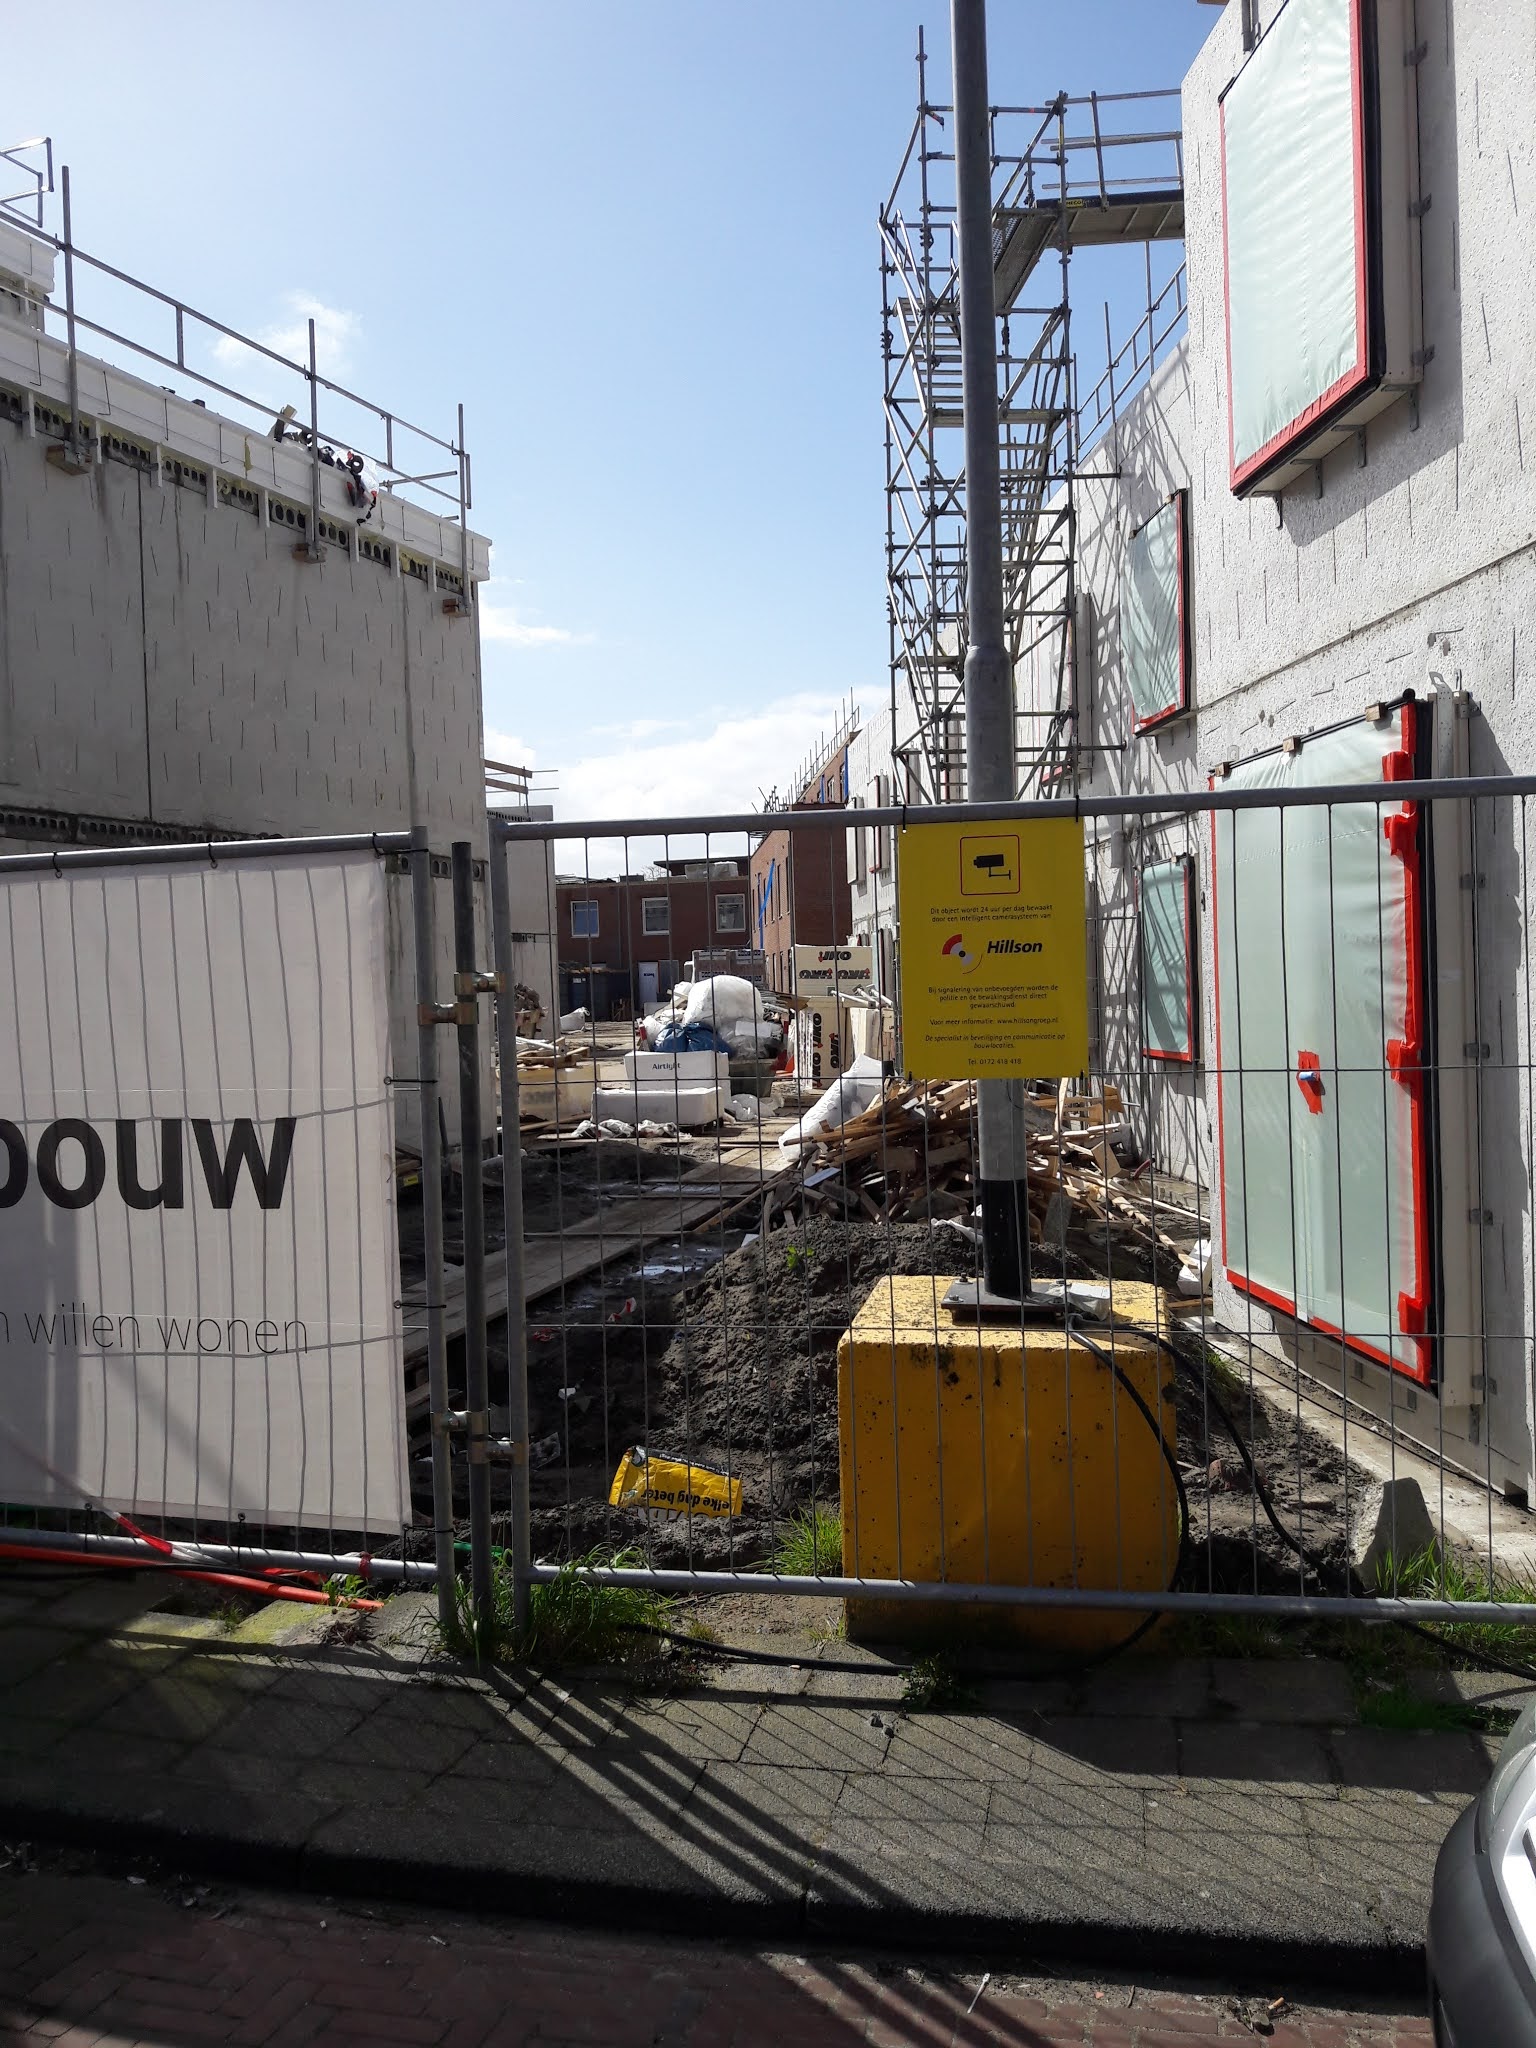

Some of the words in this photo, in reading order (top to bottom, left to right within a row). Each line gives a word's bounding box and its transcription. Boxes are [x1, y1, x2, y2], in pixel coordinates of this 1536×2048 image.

[941, 907, 960, 915] object
[986, 939, 1043, 954] Hillson
[928, 986, 937, 994] Bij
[937, 986, 971, 994] signalering
[984, 985, 1025, 993] onbevoegden
[978, 993, 1028, 1001] bewakingsdienst
[934, 1034, 962, 1042] specialist
[24, 1302, 141, 1348] willen
[156, 1317, 308, 1354] wonen
[641, 1489, 675, 1504] beter
[678, 1489, 702, 1508] dag
[702, 1496, 730, 1512] elke
